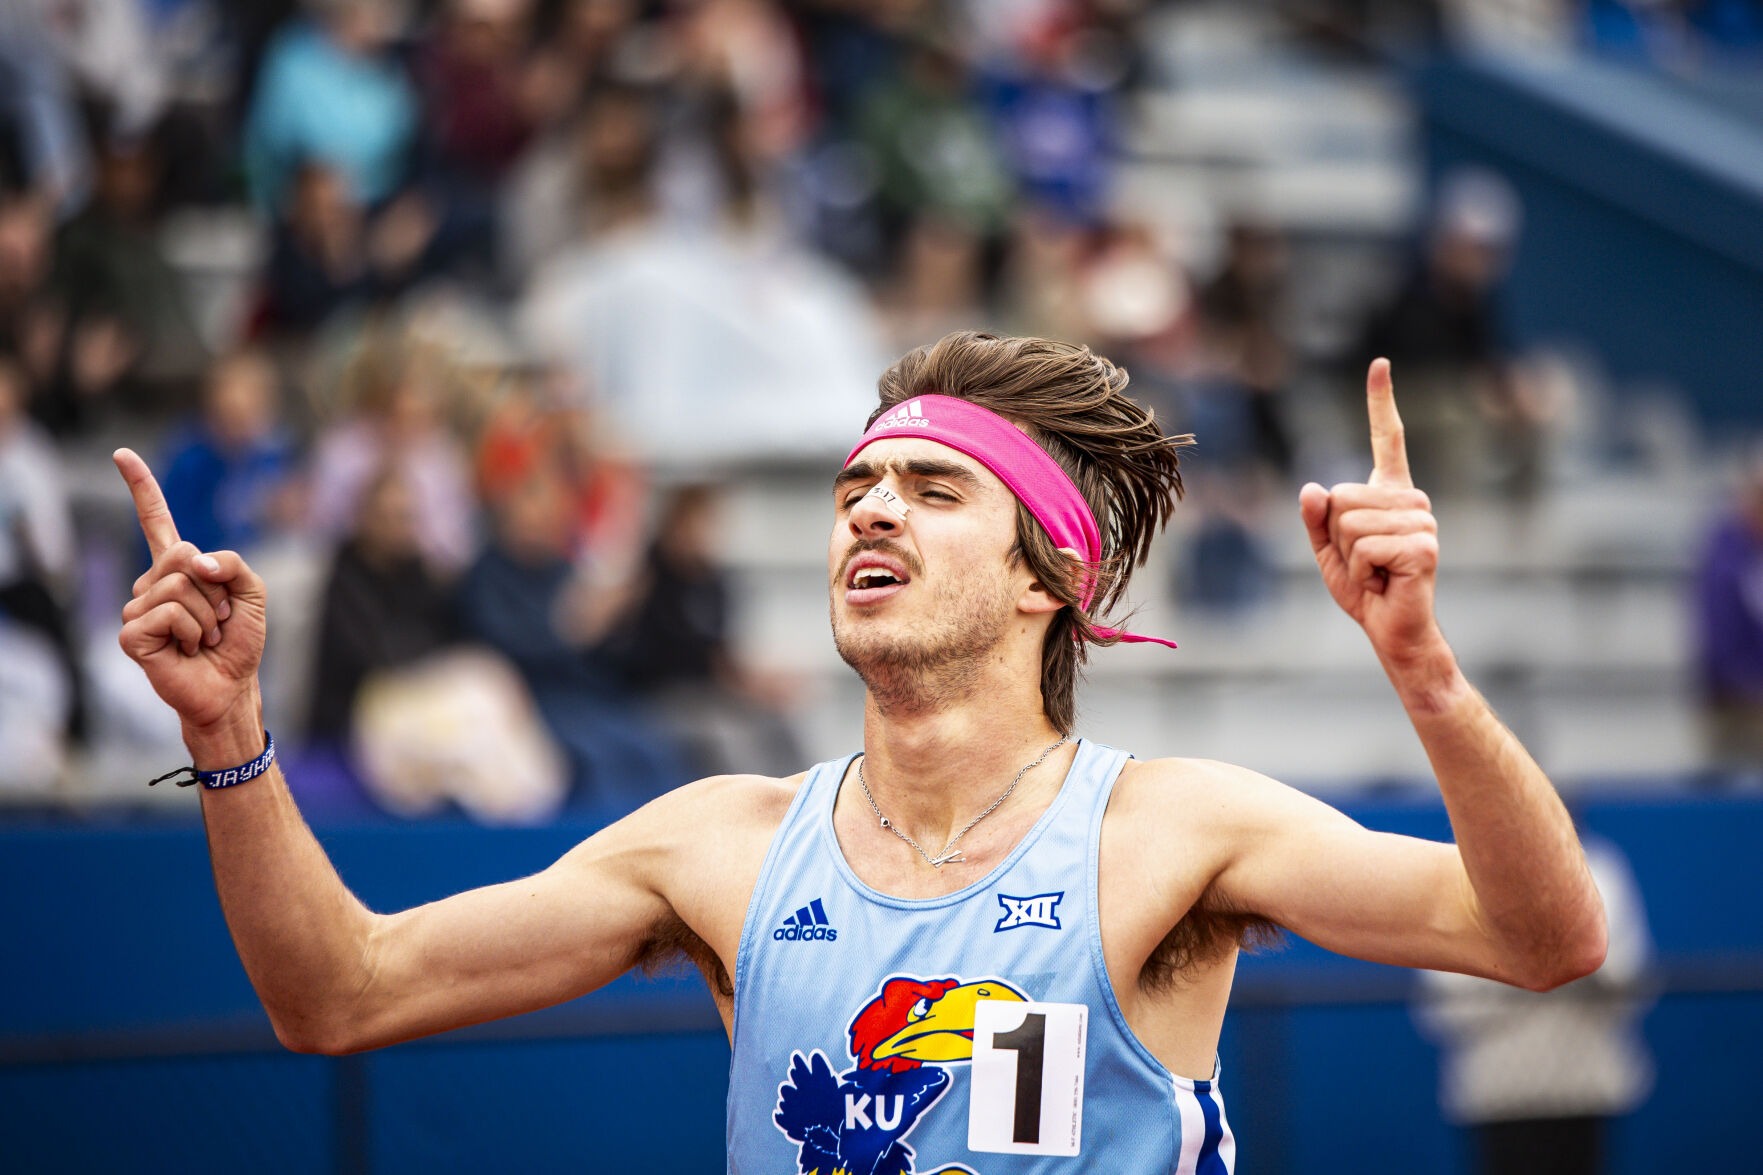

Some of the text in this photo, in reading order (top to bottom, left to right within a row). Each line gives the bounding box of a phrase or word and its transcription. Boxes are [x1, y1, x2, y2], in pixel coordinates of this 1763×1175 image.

[875, 416, 930, 432] adidas
[998, 893, 1061, 930] XII
[773, 925, 838, 942] adidas
[992, 1012, 1047, 1145] 1
[844, 1093, 905, 1131] KU
